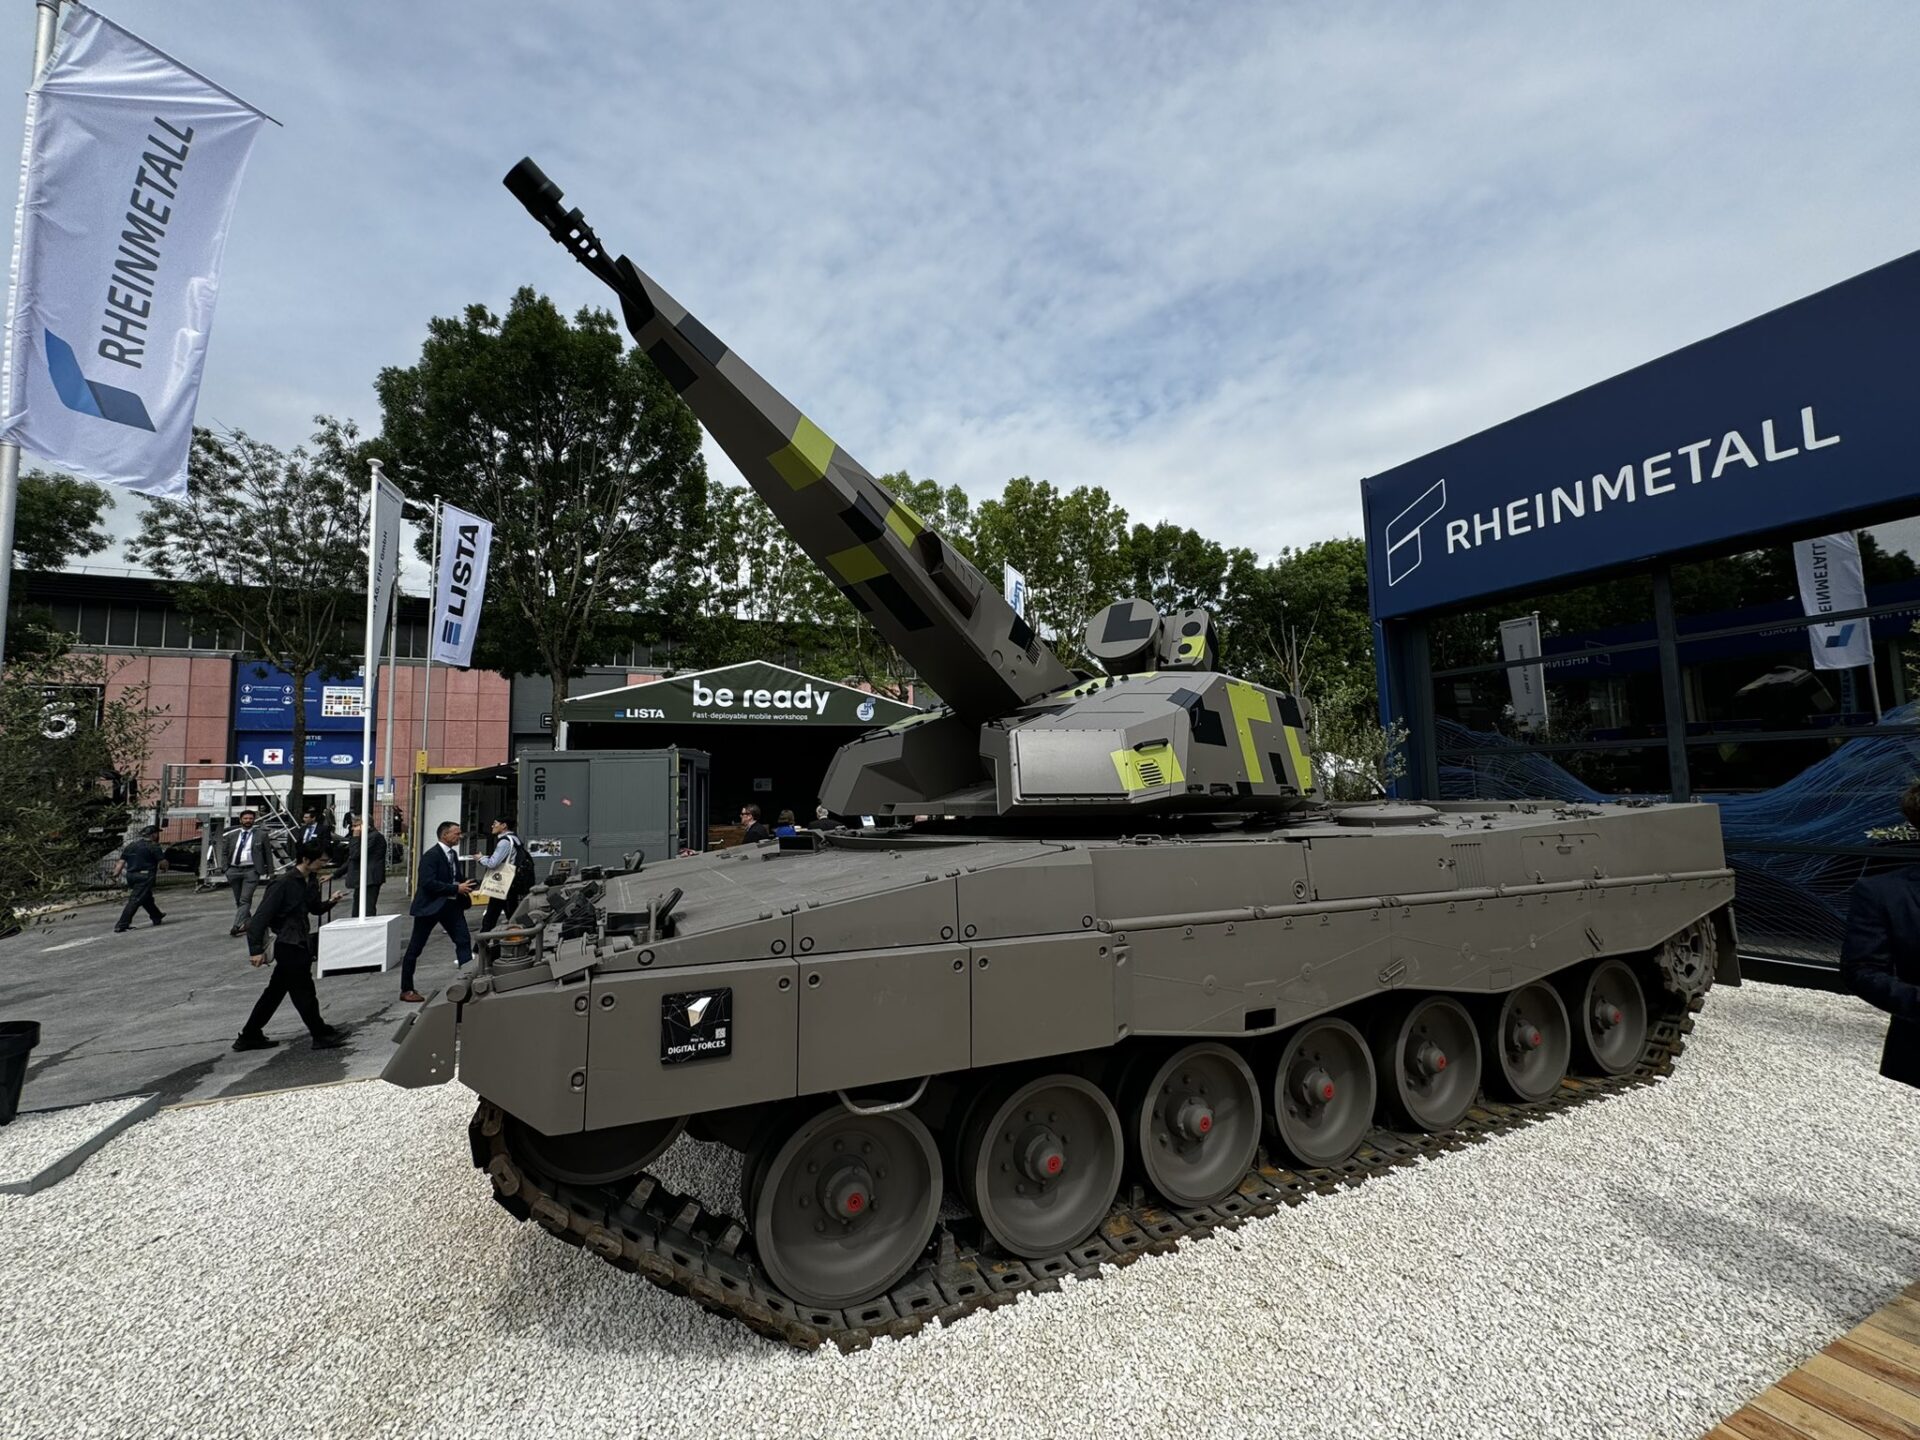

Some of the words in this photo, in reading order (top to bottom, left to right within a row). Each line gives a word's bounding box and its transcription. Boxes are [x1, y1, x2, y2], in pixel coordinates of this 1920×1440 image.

[98, 116, 195, 368] RHEINMETALL
[1446, 406, 1841, 554] RHEINMETALL
[448, 525, 480, 618] LISTA
[626, 708, 665, 719] LISTA
[692, 680, 734, 707] be
[743, 683, 830, 714] ready
[692, 711, 748, 721] Fast-deployable
[749, 712, 772, 720] mobile
[773, 713, 808, 721] workshops
[534, 767, 546, 801] CUBE
[667, 1044, 696, 1054] DIGITAL
[698, 1040, 725, 1050] FORCES
